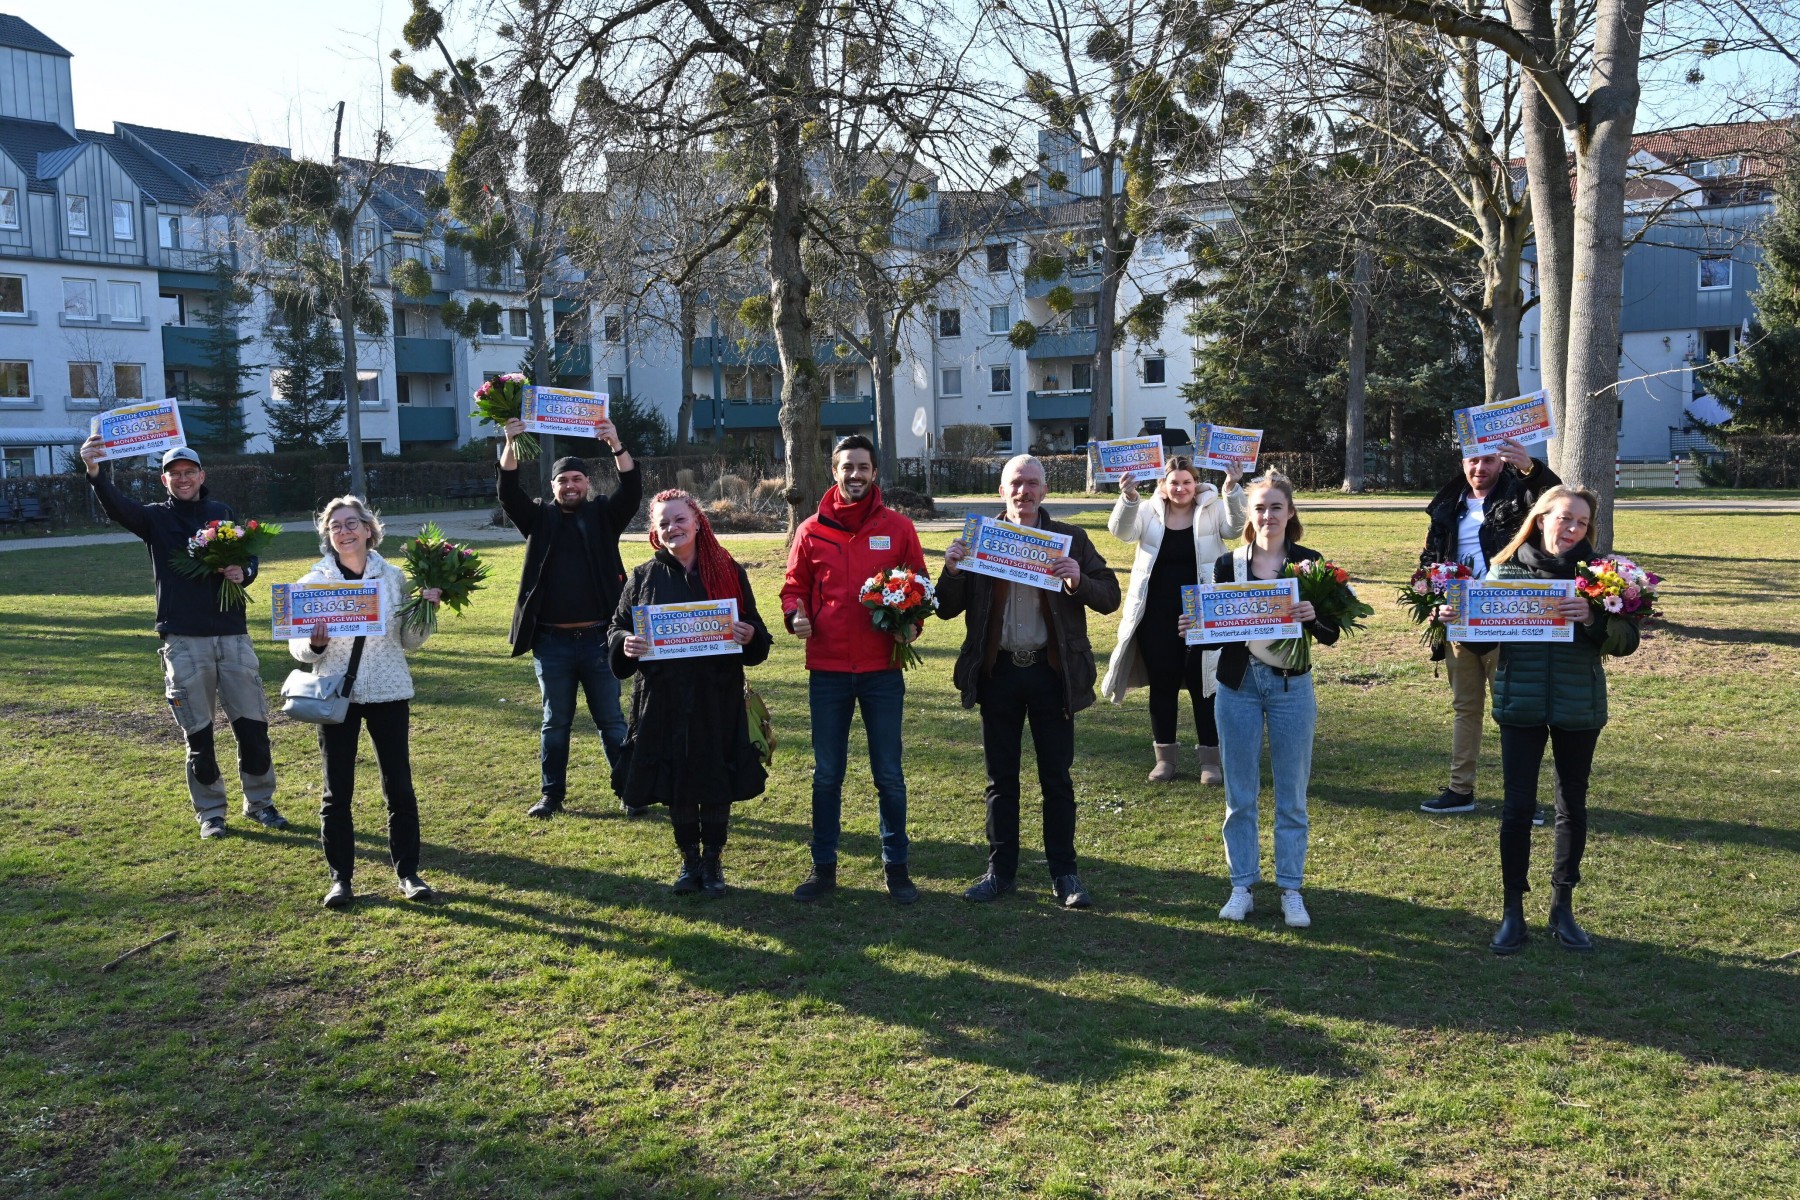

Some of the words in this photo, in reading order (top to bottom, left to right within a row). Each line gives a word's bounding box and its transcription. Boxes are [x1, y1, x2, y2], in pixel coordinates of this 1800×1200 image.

[539, 394, 573, 402] POSTCODE
[574, 397, 603, 405] LOTTERIE
[546, 404, 596, 418] €3.645,-
[1473, 408, 1513, 420] POSTCODE
[1513, 398, 1544, 412] LOTTERIE
[103, 413, 138, 425] POSTCODE
[139, 407, 171, 418] LOTTERIE
[544, 416, 596, 426] MONATSGEWINN
[1484, 413, 1540, 432] €3.645,-
[111, 420, 167, 436] €3.645,-
[1457, 413, 1473, 446] SCHECK
[1486, 423, 1541, 441] MONATSGEWINN
[113, 431, 169, 446] MONATSGEWINN
[1213, 432, 1243, 441] POSTCODE
[1101, 445, 1132, 453] POSTCODE
[983, 526, 1025, 541] POSTCODE
[1025, 535, 1062, 550] LOTTERIE
[978, 561, 1008, 574] Postcode:
[986, 554, 1048, 574] MONATSGEWINN
[293, 589, 337, 599] POSTCODE
[338, 588, 375, 596] LOTTERIE
[1203, 591, 1248, 600] POSTCODE
[1249, 588, 1289, 597] LOTTERIE
[274, 586, 285, 627] SCHECK
[303, 600, 366, 613] €3.645,-
[1214, 601, 1280, 616] €3.645,-
[1480, 601, 1553, 615] €3.645,-
[302, 615, 367, 624] MONATSGEWINN
[652, 612, 692, 620] POSTCODE
[693, 608, 729, 617] LOTTERIE
[655, 619, 729, 635] €350.000,-
[1214, 617, 1282, 627] MONATSGEWINN
[1480, 618, 1553, 626] MONATSGEWINN
[1254, 627, 1275, 635] 53129
[1521, 628, 1544, 636] 53129
[663, 635, 724, 645] MONATSGEWINN
[659, 646, 688, 655] Postcode:
